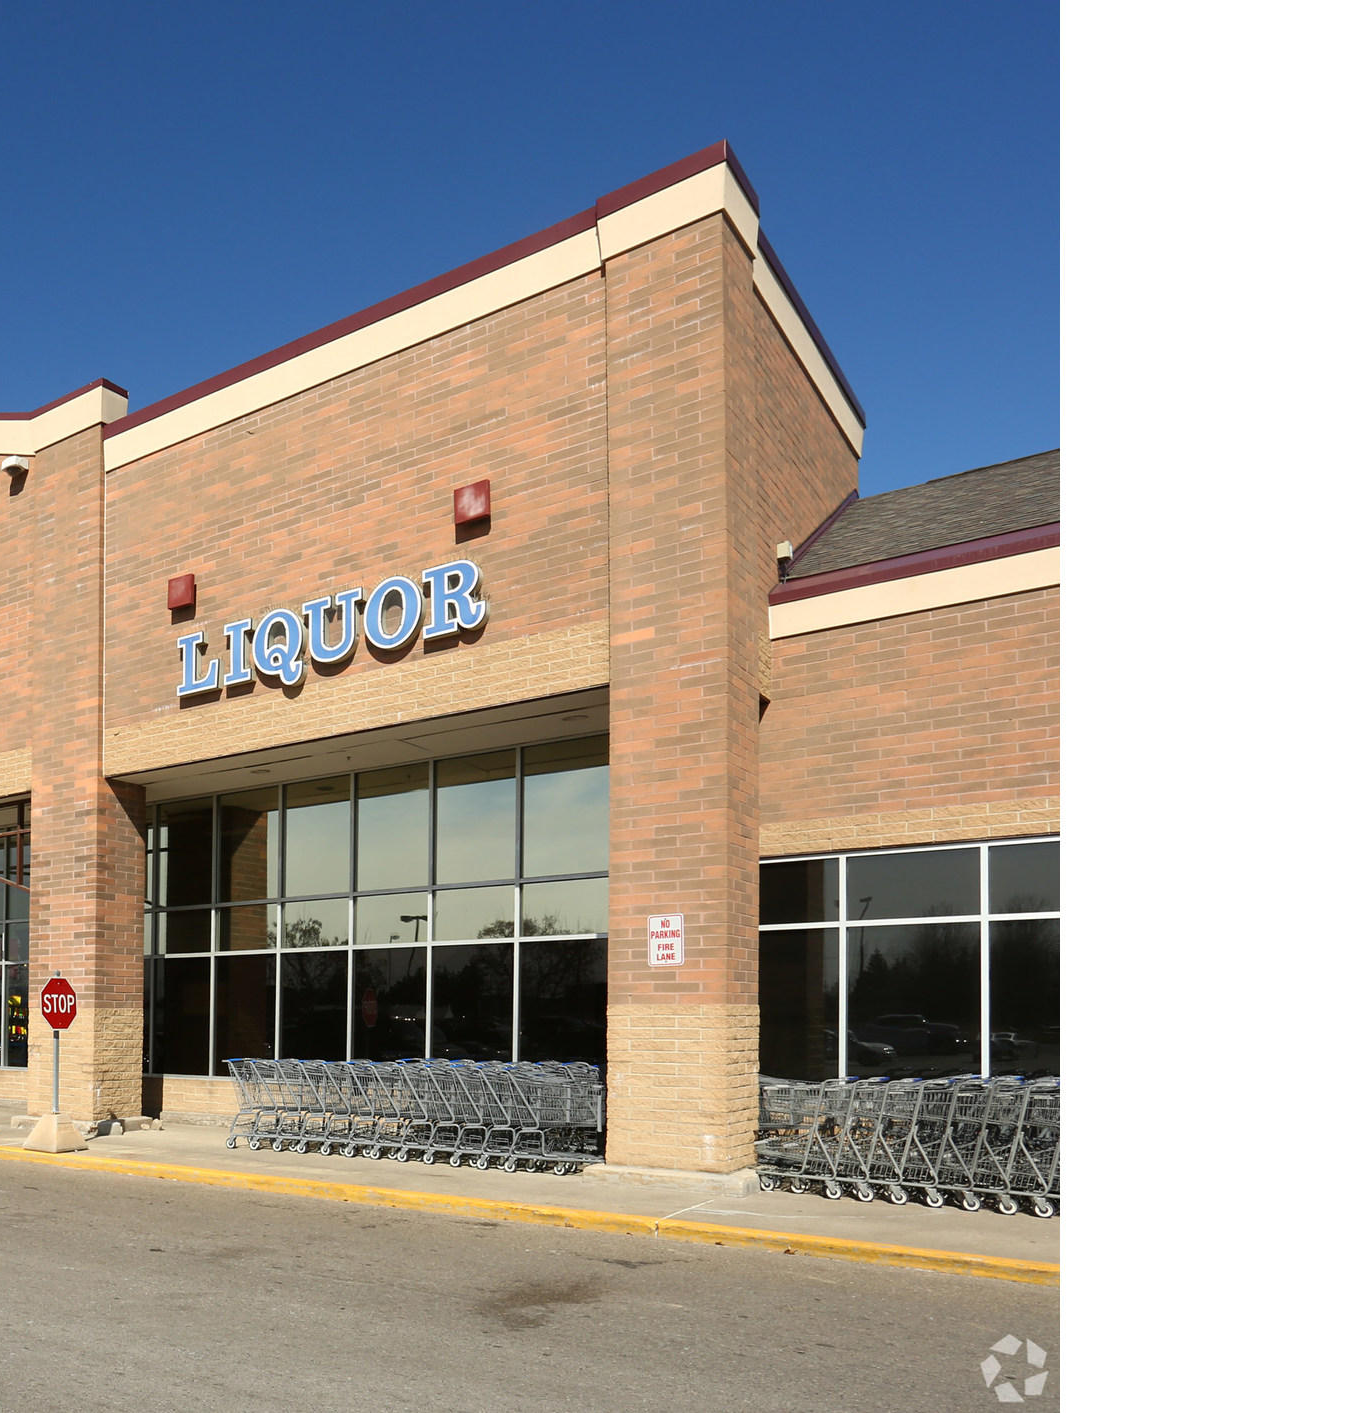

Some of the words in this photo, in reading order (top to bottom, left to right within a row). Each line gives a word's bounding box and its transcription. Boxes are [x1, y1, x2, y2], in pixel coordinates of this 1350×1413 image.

[176, 558, 487, 697] LIQUOR
[660, 919, 670, 928] NO
[650, 929, 680, 939] PARKING
[657, 943, 675, 951] FIRE
[656, 952, 676, 961] LANE
[43, 993, 75, 1014] STOP
